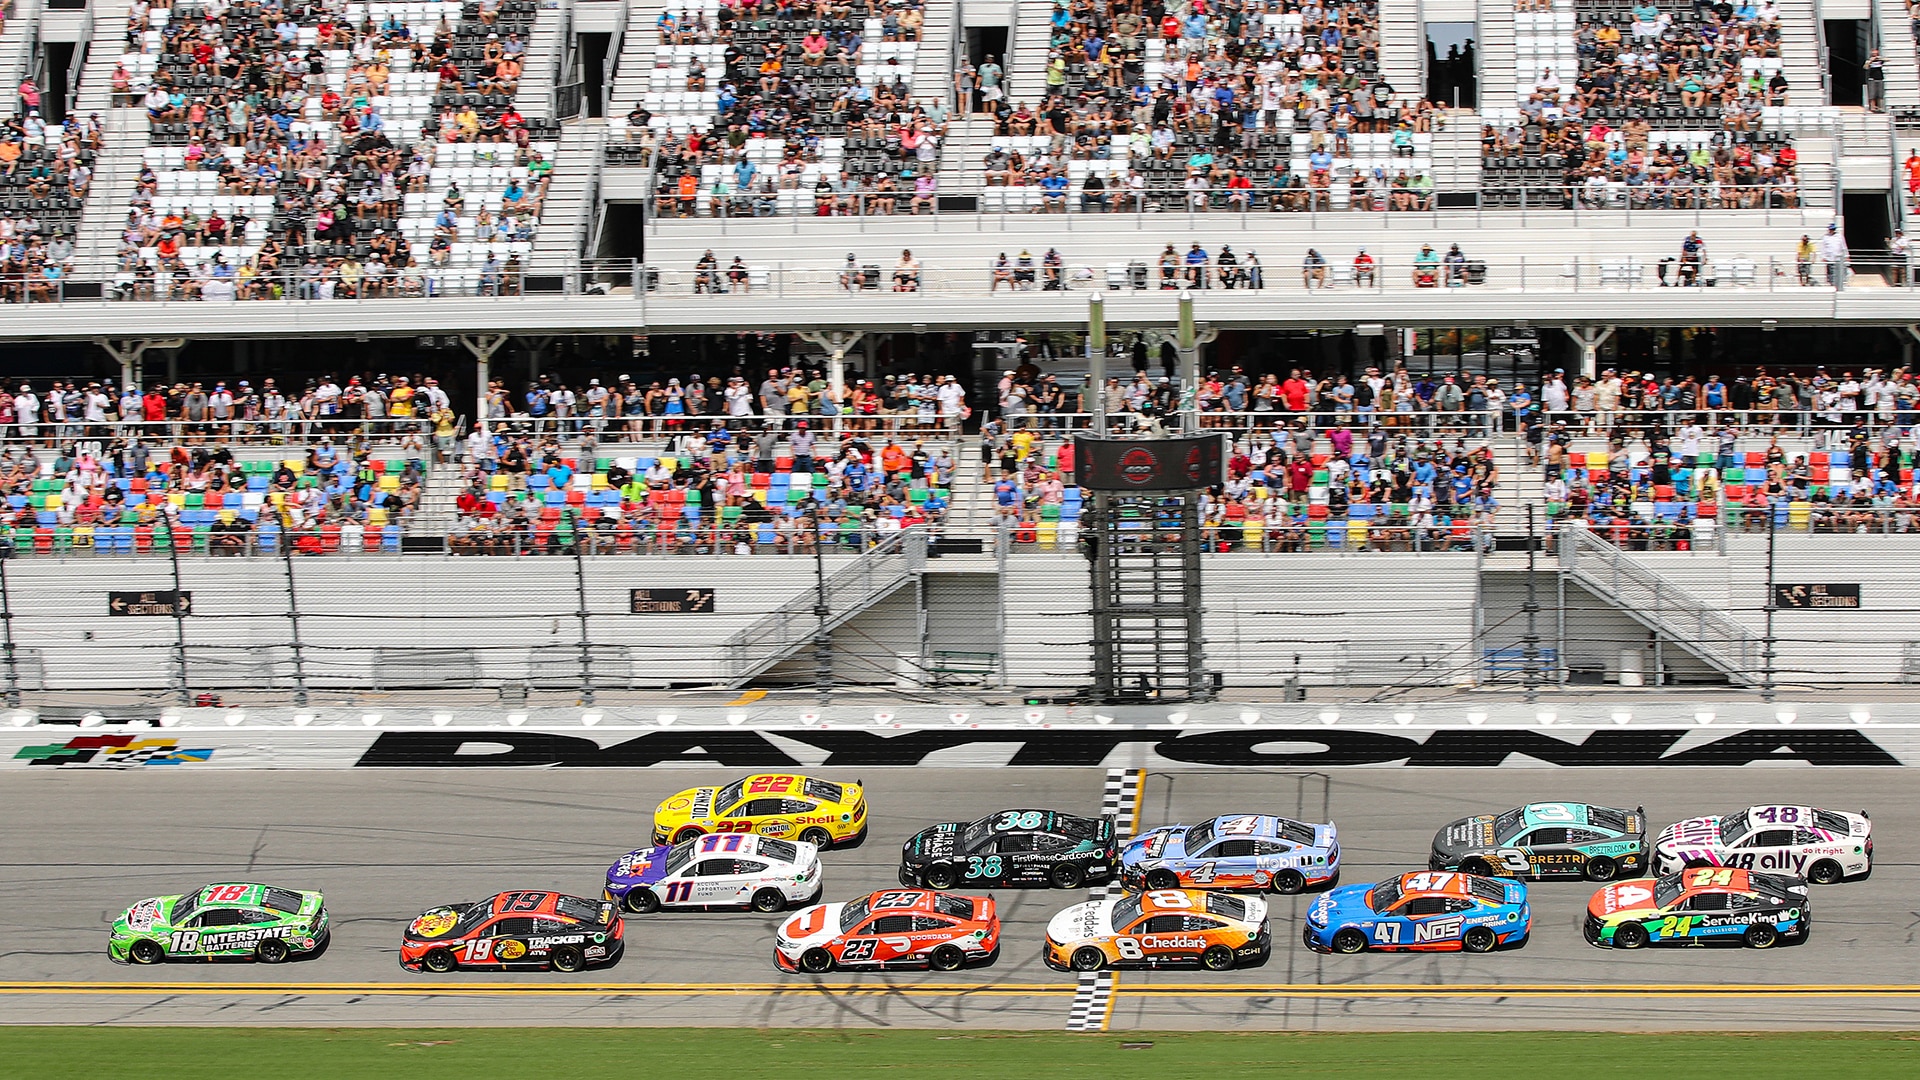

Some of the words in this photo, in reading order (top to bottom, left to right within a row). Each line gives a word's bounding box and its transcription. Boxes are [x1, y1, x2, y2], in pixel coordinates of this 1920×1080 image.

[139, 593, 157, 603] ALL
[634, 590, 652, 600] ALL
[1810, 584, 1829, 595] ALL
[127, 604, 174, 614] SECTIONS
[634, 601, 681, 611] SECTIONS
[1809, 596, 1857, 606] SECTIONS
[353, 730, 1904, 767] DAYTONA
[749, 776, 795, 793] 22
[795, 815, 835, 825] Shell
[995, 811, 1043, 830] 38
[1528, 804, 1575, 821] 3
[1757, 806, 1799, 823] 48
[761, 824, 790, 834] PENNZOIL
[1218, 815, 1259, 835] 4
[700, 834, 744, 852] 11
[931, 833, 944, 858] PHASE
[942, 832, 955, 857] FIRST
[1012, 849, 1095, 863] FirstPhaseCard.com
[1256, 856, 1298, 868] Mobil
[1497, 849, 1530, 871] 3
[1529, 854, 1585, 864] BREZTRI
[1722, 852, 1756, 869] 48
[1760, 849, 1808, 874] ally
[965, 855, 1003, 878] 38
[1189, 861, 1216, 884] 4
[1406, 873, 1456, 892] 47
[1692, 869, 1734, 886] 24
[202, 884, 250, 902] 18
[665, 881, 694, 903] 11
[873, 892, 925, 909] 23
[1147, 890, 1193, 908] 8
[1604, 886, 1617, 914] AXALTA
[500, 892, 548, 912] 19
[1466, 914, 1500, 924] ENERGY
[1482, 920, 1507, 928] DRINK
[1659, 915, 1694, 937] 24
[202, 925, 292, 946] INTERSTATE
[527, 935, 585, 945] TRACKER
[910, 933, 952, 941] DOORDASH
[1374, 922, 1401, 943] 47
[1414, 922, 1461, 943] NOS
[169, 931, 200, 953] 18
[205, 939, 260, 952] BATTERIES
[464, 939, 493, 961] 19
[841, 938, 879, 960] 23
[1114, 937, 1144, 959] 8
[1141, 935, 1207, 949] Cheddar's
[1238, 947, 1261, 956] 3CHI
